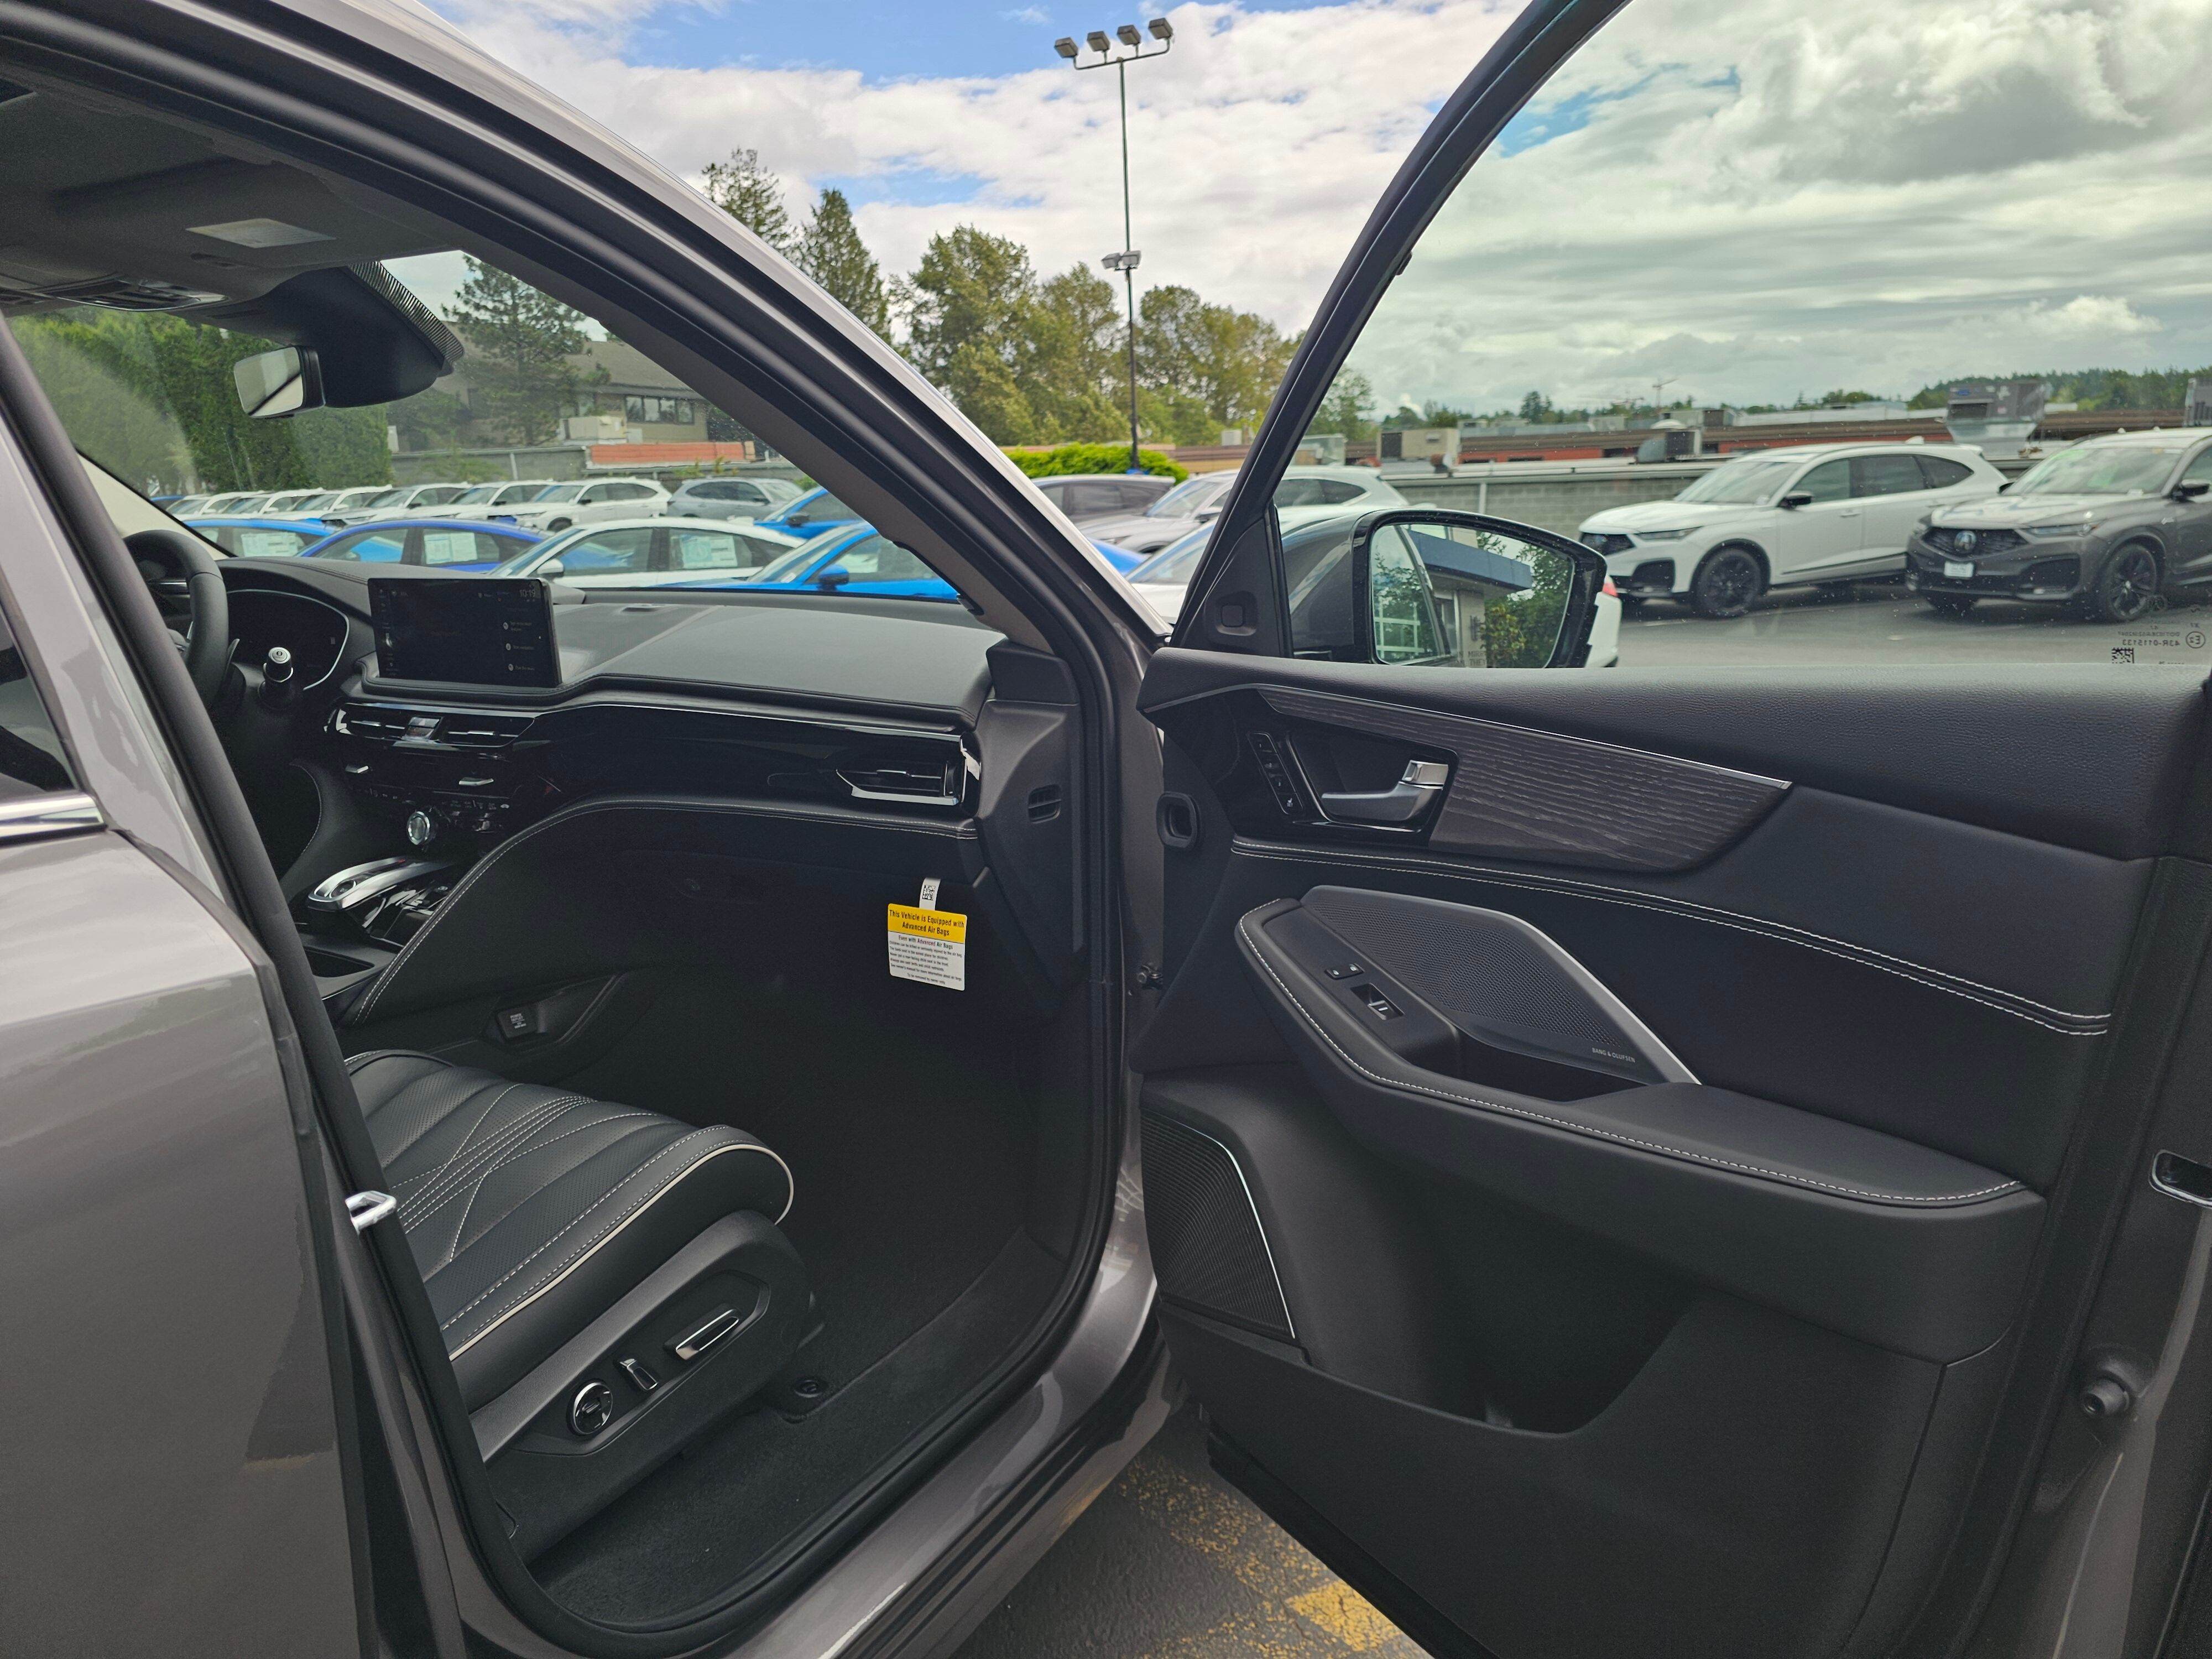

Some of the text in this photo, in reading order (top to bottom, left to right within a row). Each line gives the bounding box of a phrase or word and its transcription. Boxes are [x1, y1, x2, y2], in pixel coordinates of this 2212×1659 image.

[519, 589, 536, 598] 10:19
[901, 912, 919, 921] Vehicle
[928, 916, 952, 926] Equipped
[902, 922, 926, 932] Advanced
[937, 927, 949, 936] Bags
[1592, 1047, 1606, 1056] BANG
[1612, 1052, 1635, 1063] OLUFSEN
